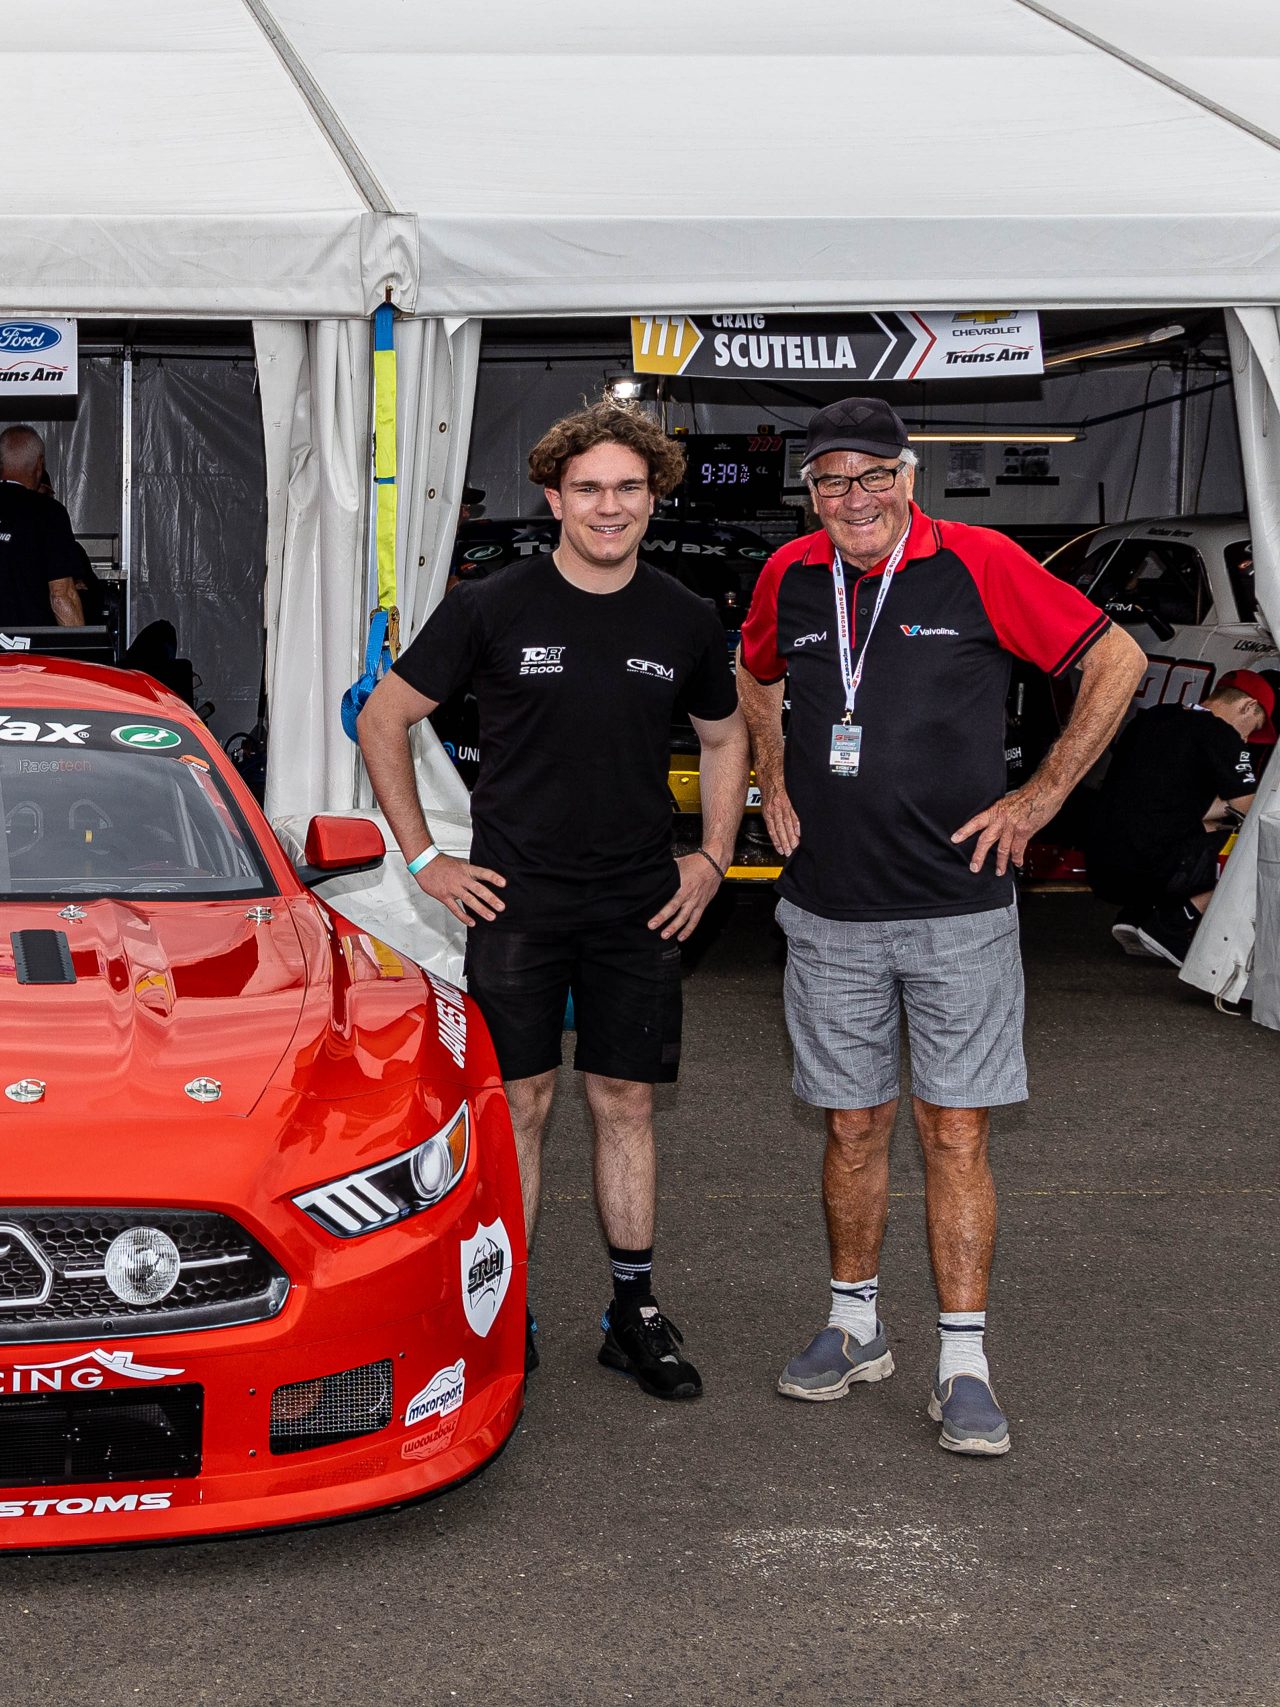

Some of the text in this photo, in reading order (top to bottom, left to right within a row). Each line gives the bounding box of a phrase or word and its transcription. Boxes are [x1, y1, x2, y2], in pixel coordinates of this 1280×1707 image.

[712, 313, 765, 329] CRAIG
[636, 316, 686, 357] 777
[952, 326, 1021, 337] CHEVROLET
[714, 333, 857, 370] SCUTELLA
[945, 348, 1030, 365] Trans Am
[33, 367, 64, 381] Am
[701, 463, 738, 484] 9:39
[920, 628, 956, 636] Valvoline
[521, 647, 563, 662] TCR
[520, 665, 564, 675] S5000
[626, 658, 674, 679] GRM
[21, 759, 93, 774] Racetech
[435, 998, 467, 1069] JAMES
[408, 1382, 463, 1422] motorsport
